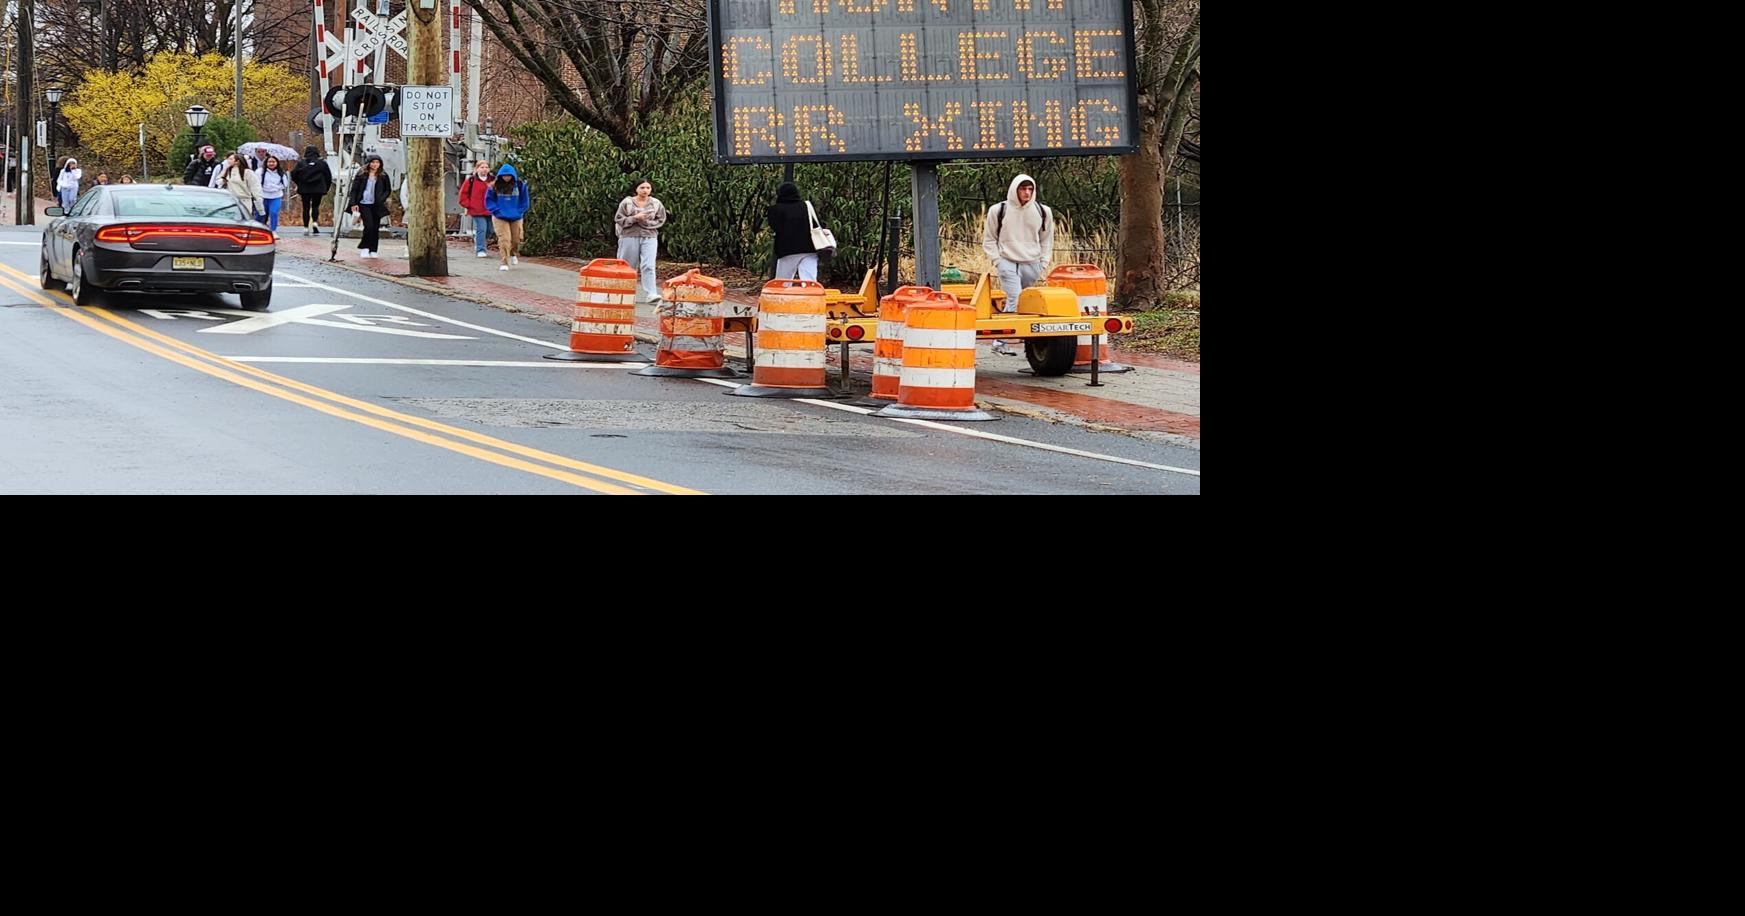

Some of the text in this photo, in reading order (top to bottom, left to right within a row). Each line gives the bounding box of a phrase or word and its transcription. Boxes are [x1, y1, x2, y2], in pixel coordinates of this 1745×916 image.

[354, 15, 408, 57] CROSSIN
[722, 29, 1126, 85] COLLEGE
[406, 91, 448, 99] DO NOT
[412, 102, 442, 110] STOP
[419, 112, 435, 121] ON
[404, 123, 450, 132] TRACKS
[733, 98, 1120, 157] RR XING
